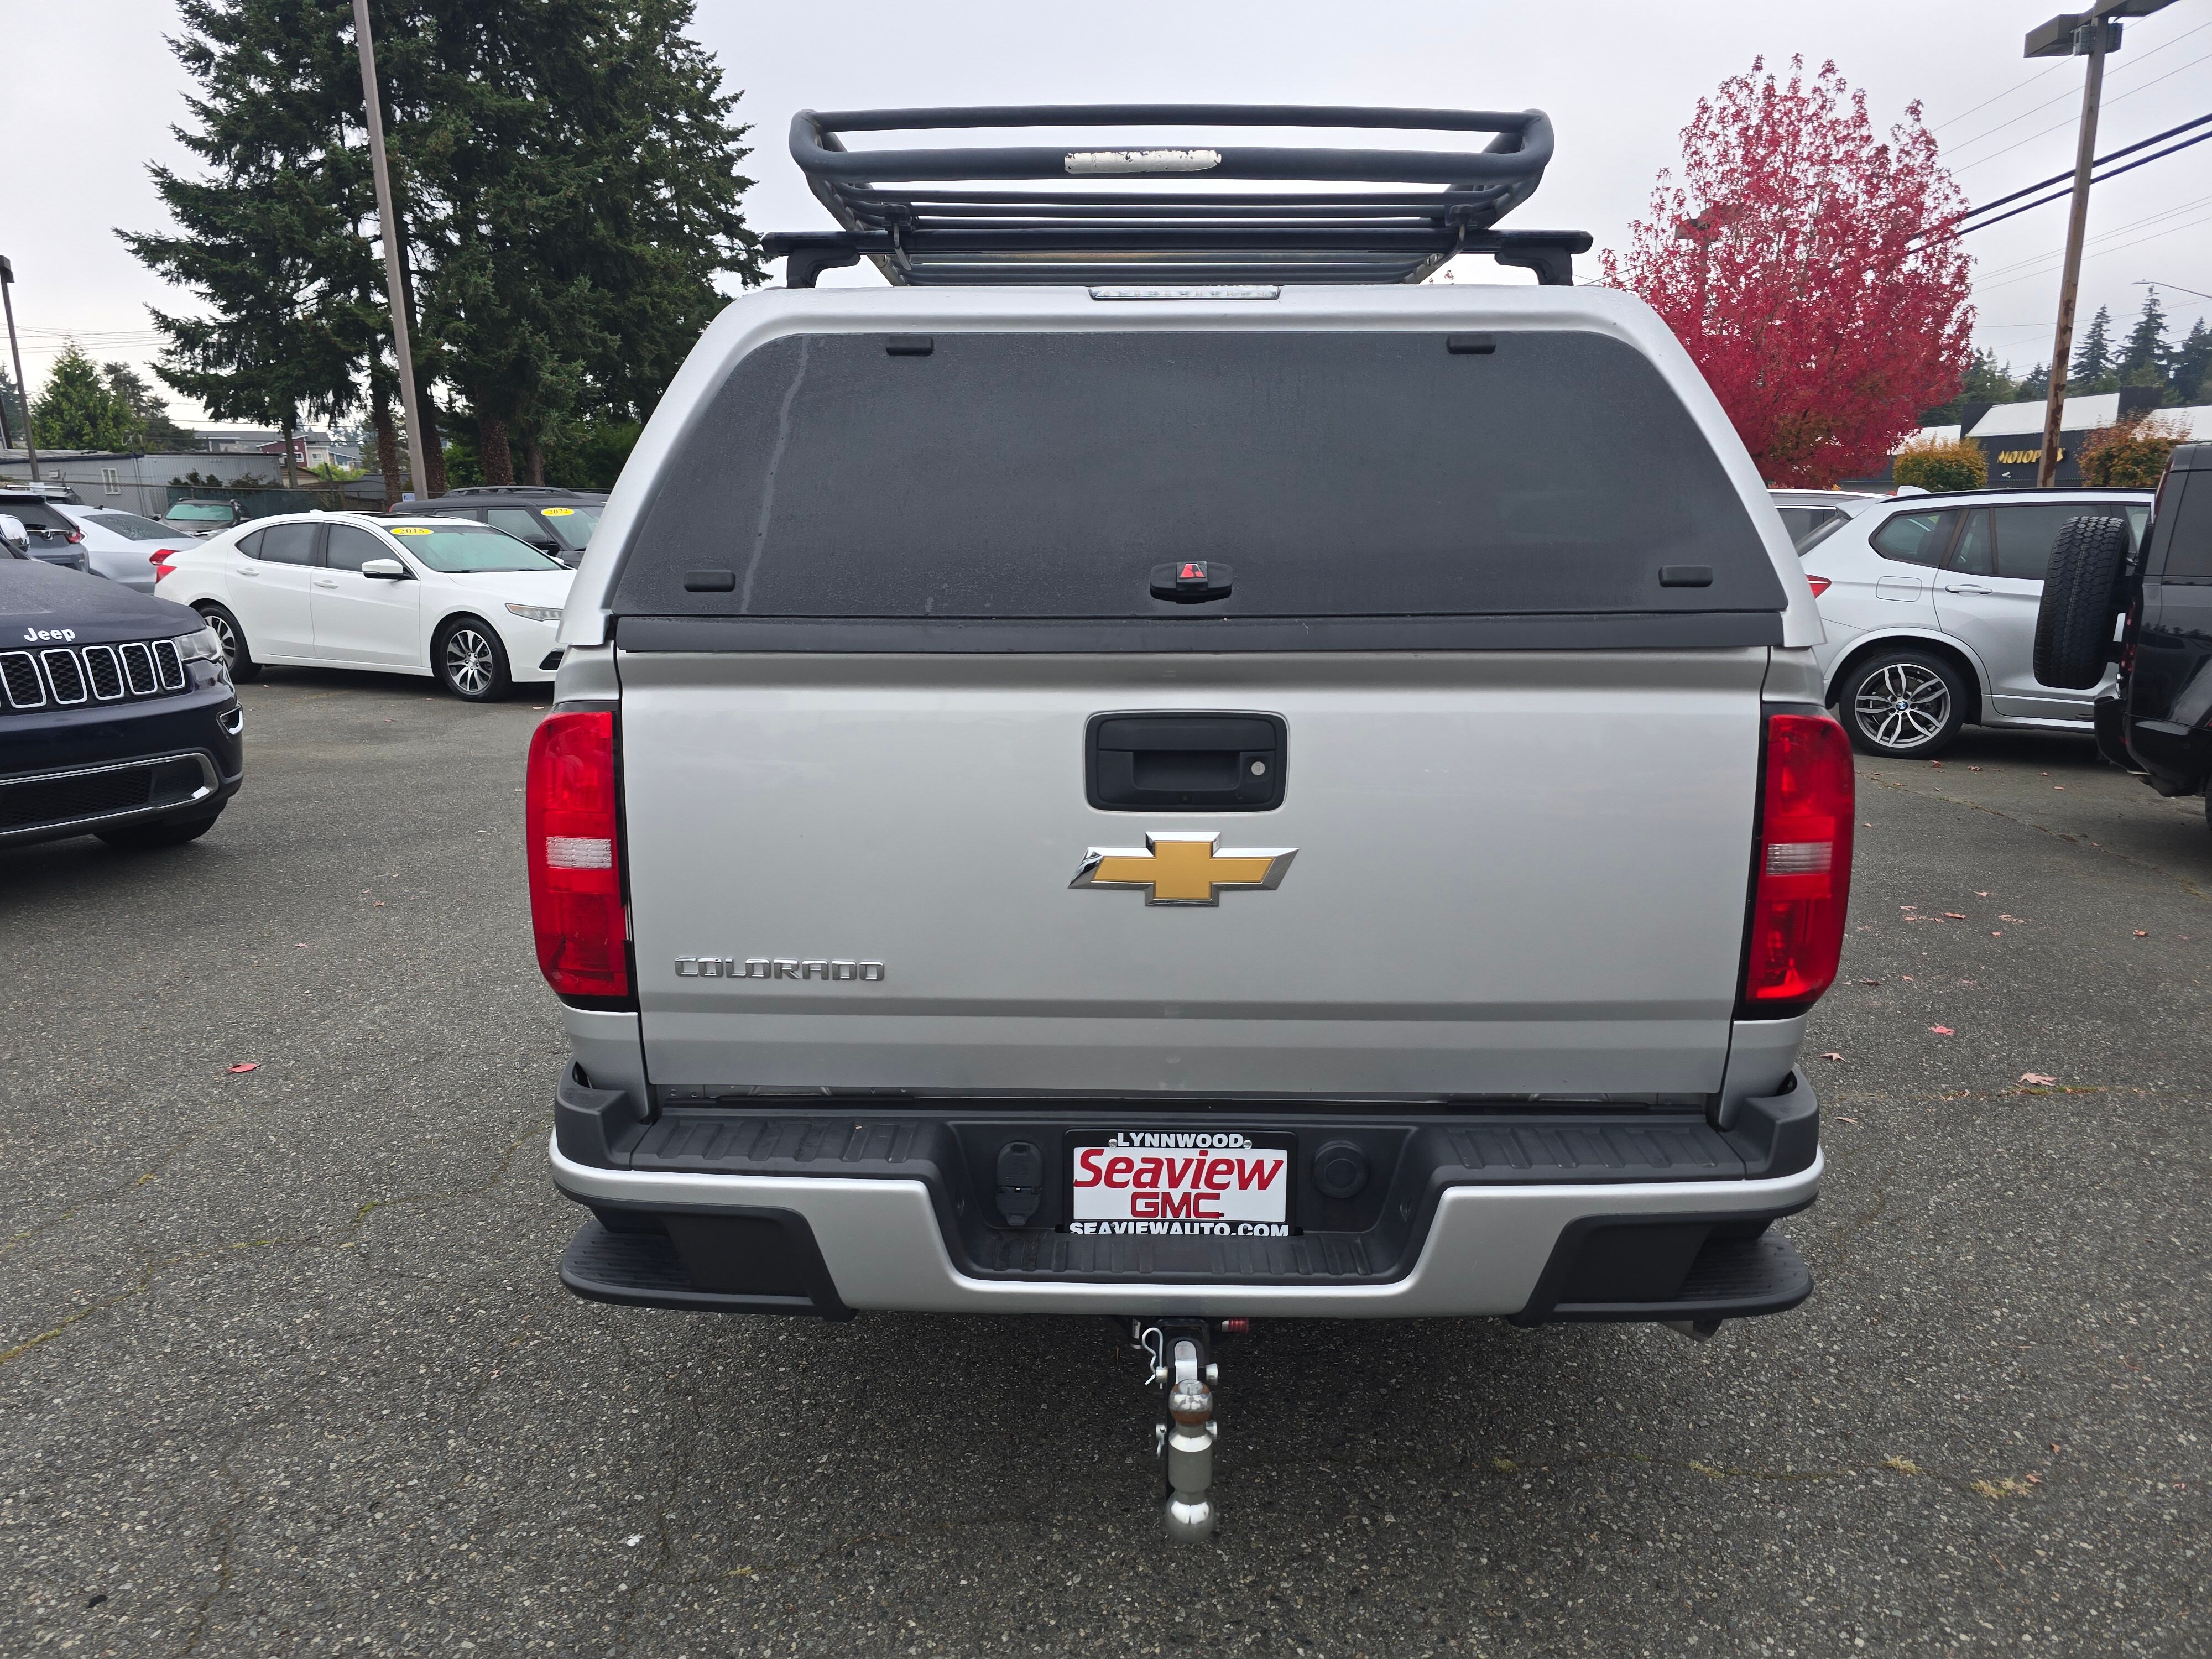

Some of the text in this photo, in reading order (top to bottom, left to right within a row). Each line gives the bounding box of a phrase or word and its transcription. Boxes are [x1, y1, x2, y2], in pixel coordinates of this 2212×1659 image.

[24, 628, 76, 642] Jeep
[675, 957, 885, 981] COLORADO
[1118, 1132, 1244, 1147] LYNNWOOD
[1074, 1149, 1284, 1191] Seaview
[1130, 1191, 1220, 1219] GMC
[1069, 1222, 1289, 1237] SEAVIEWAUTO.COM
